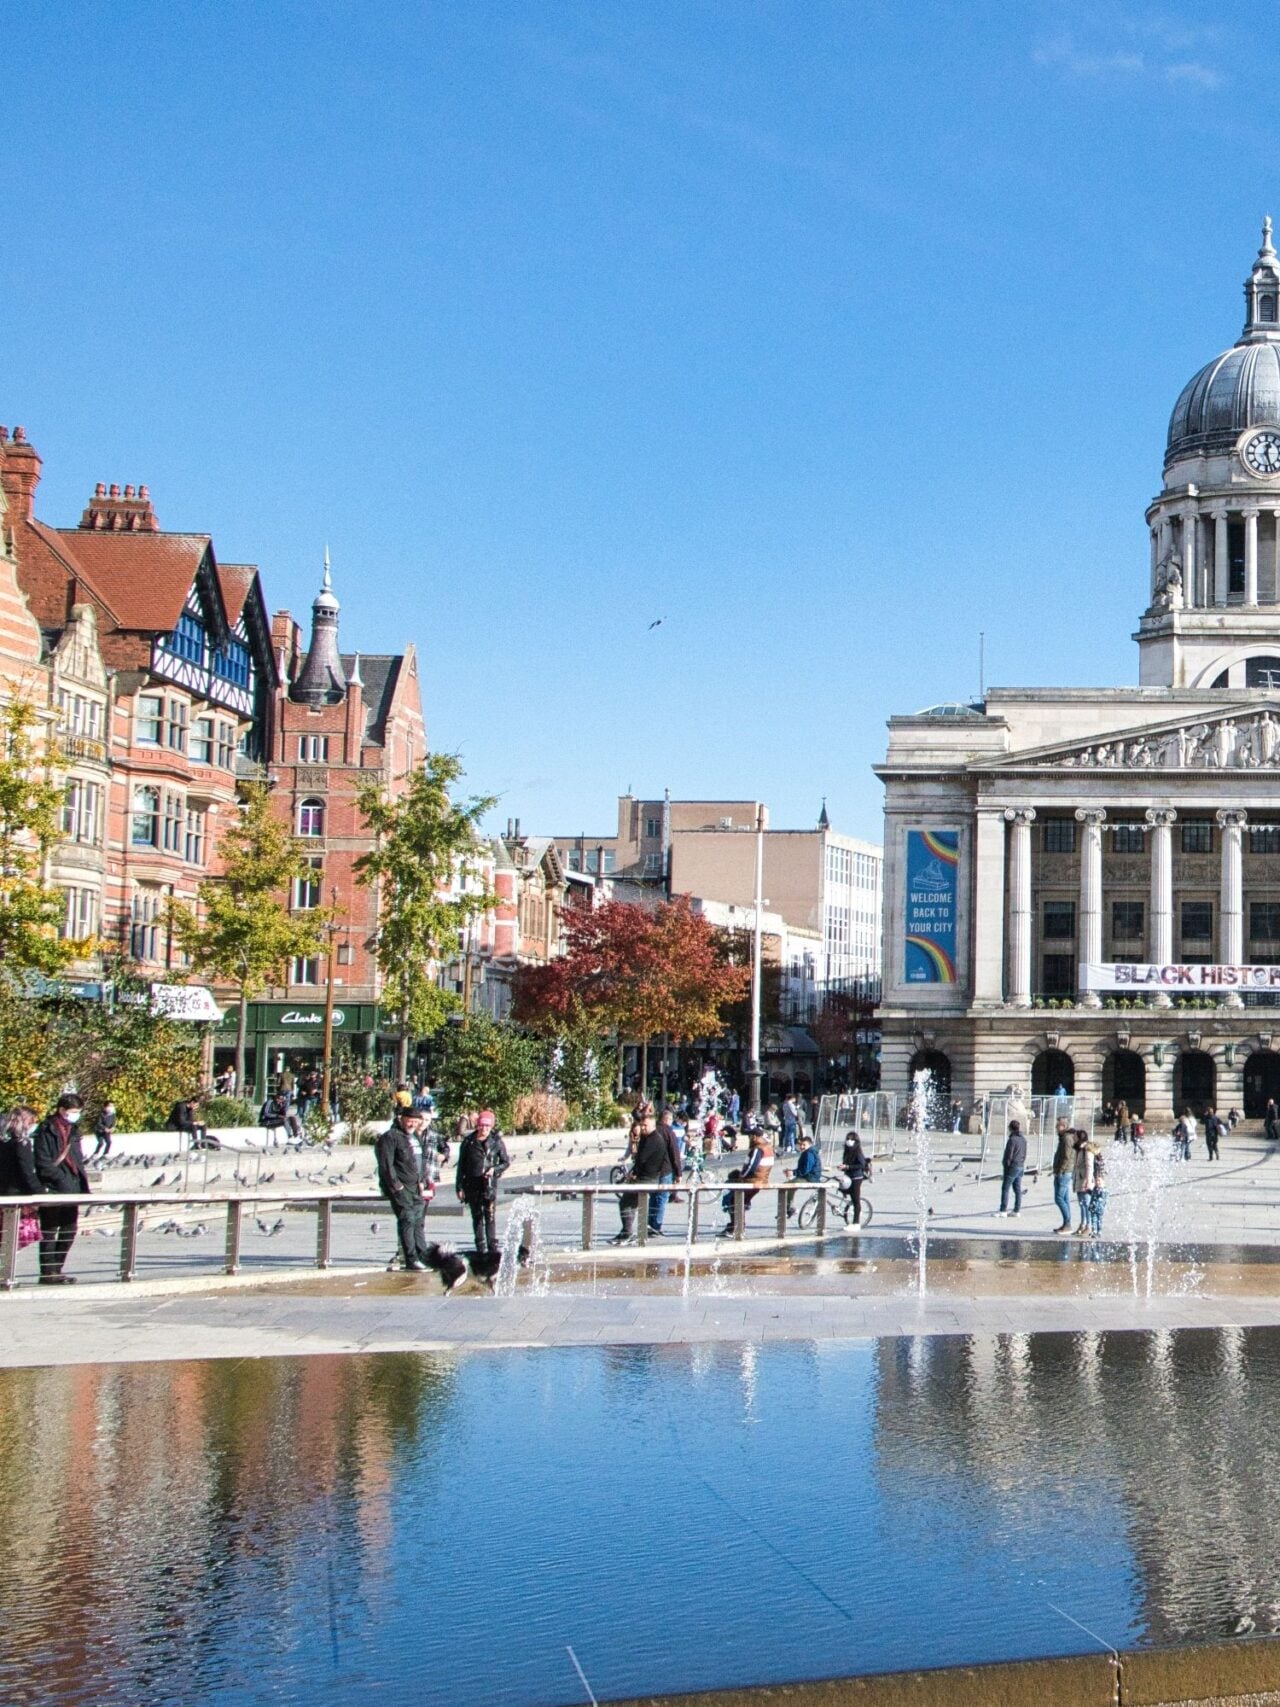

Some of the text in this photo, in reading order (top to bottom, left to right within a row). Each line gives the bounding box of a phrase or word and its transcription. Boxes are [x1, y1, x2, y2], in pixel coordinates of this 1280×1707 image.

[910, 892, 953, 903] WELCOME
[913, 907, 949, 918] BACK TO
[909, 922, 953, 933] YOUR CITY
[1114, 965, 1196, 985] BLACK
[280, 1011, 322, 1024] Clarks
